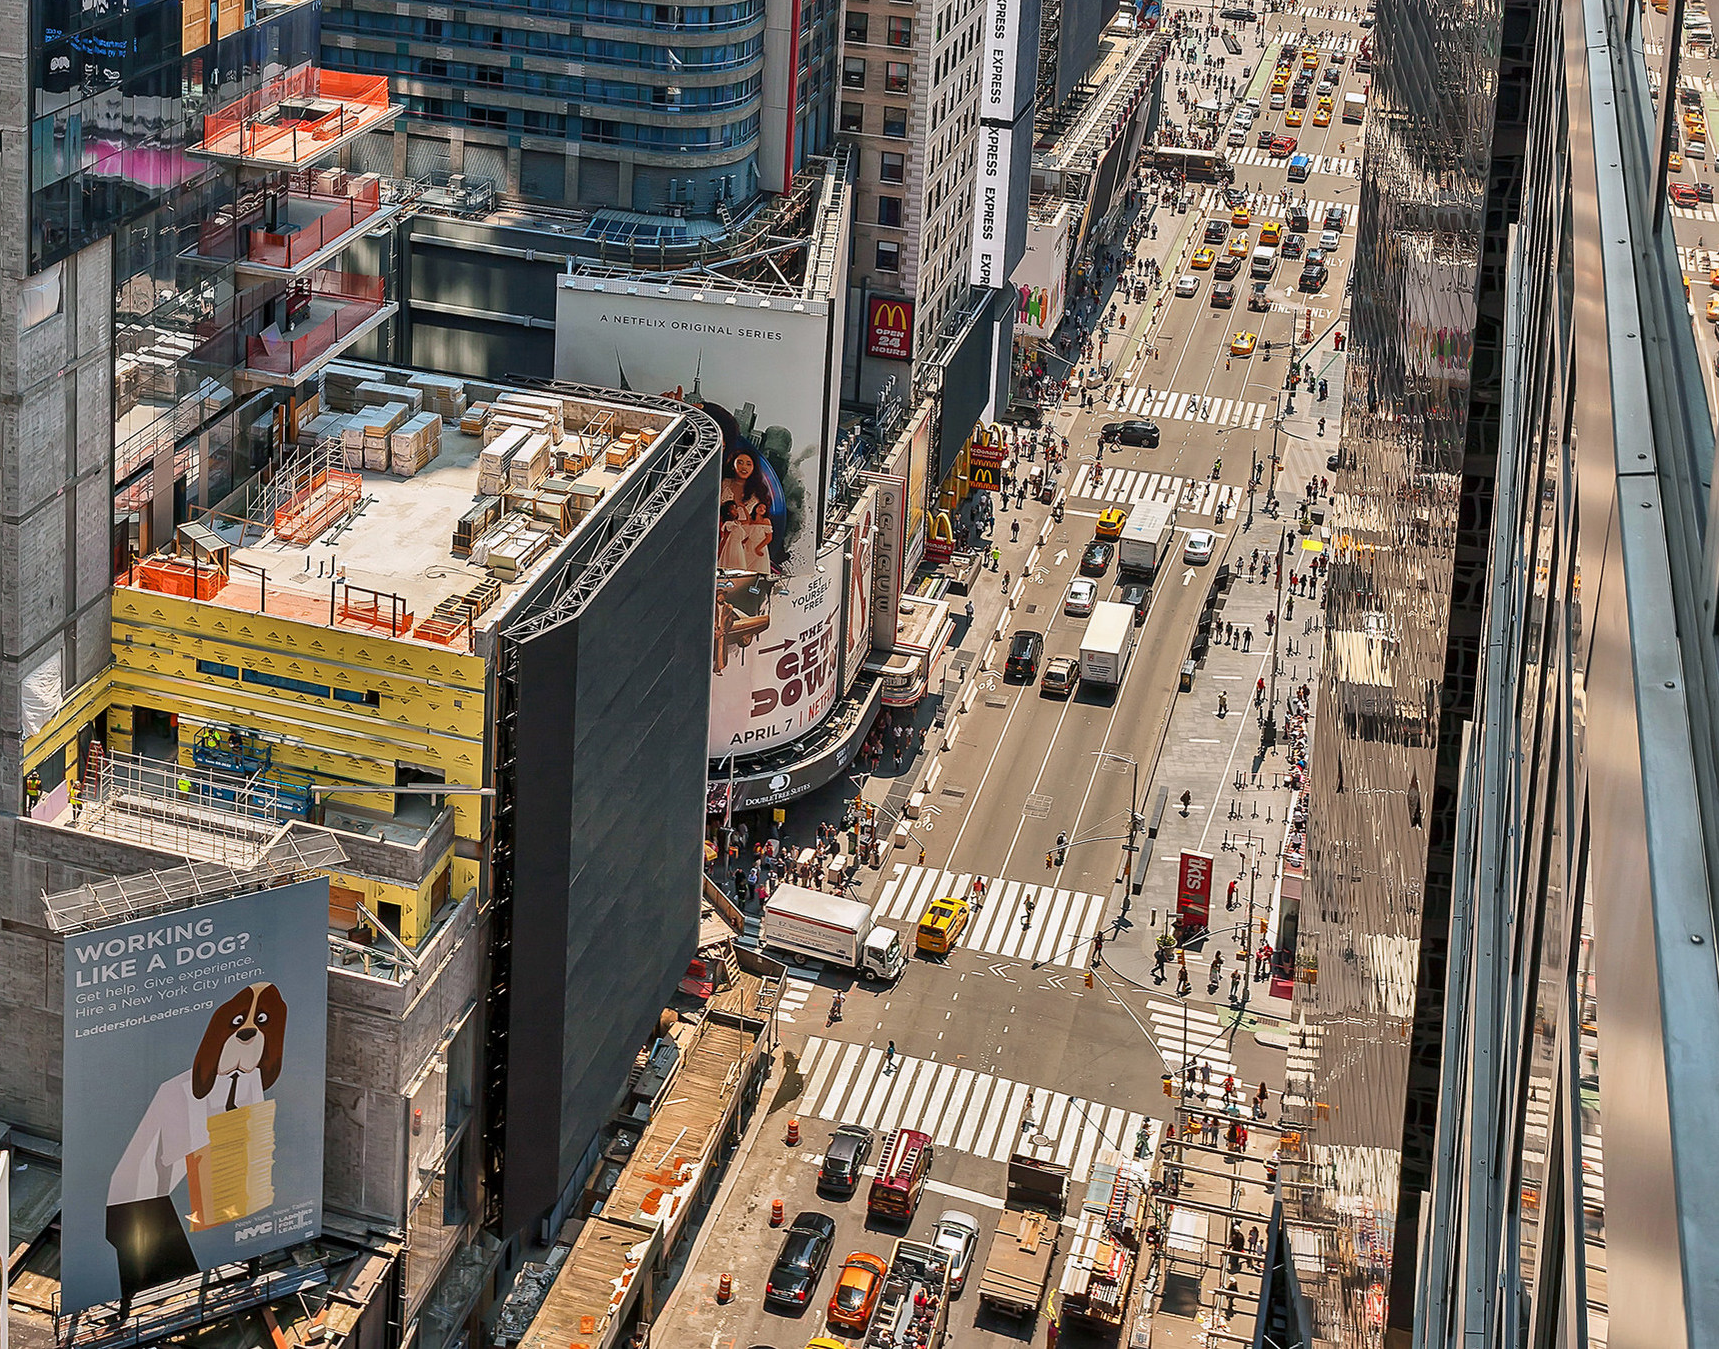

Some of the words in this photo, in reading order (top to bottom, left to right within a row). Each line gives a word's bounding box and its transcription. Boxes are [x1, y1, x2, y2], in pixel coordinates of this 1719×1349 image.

[990, 48, 1004, 105] EXPRESS
[985, 126, 999, 177] XPRESS
[983, 187, 996, 241] EXPRESS
[599, 314, 609, 323] A
[613, 315, 666, 328] NETFLIX
[671, 321, 733, 335] ORIGINAL
[738, 328, 782, 341] SERIES
[875, 328, 905, 338] OPEN
[878, 336, 901, 348] 24
[871, 346, 907, 357] HOURS
[875, 491, 895, 613] PALACE
[791, 577, 832, 608] YOURSELF
[808, 576, 822, 592] SET
[804, 594, 824, 613] FREE
[799, 620, 824, 643] THE
[776, 624, 833, 680] GET
[730, 723, 780, 746] APRIL
[785, 719, 793, 732] 7
[1186, 858, 1207, 890] tkts
[75, 918, 214, 964] WORKING
[76, 959, 137, 988] LIKE
[146, 954, 166, 972] A
[176, 932, 251, 966] DOG?
[75, 991, 101, 1004] Get
[105, 984, 139, 1001] help.
[143, 975, 174, 989] Give
[178, 955, 255, 981] experience.
[75, 1005, 104, 1019] Hire
[108, 1002, 117, 1012] a
[121, 995, 153, 1009] New
[157, 986, 188, 1000] York
[192, 978, 219, 993] City
[224, 967, 265, 985] intern.
[75, 1000, 214, 1039] LaddersforLeaders.org
[234, 1221, 273, 1243] NYC
